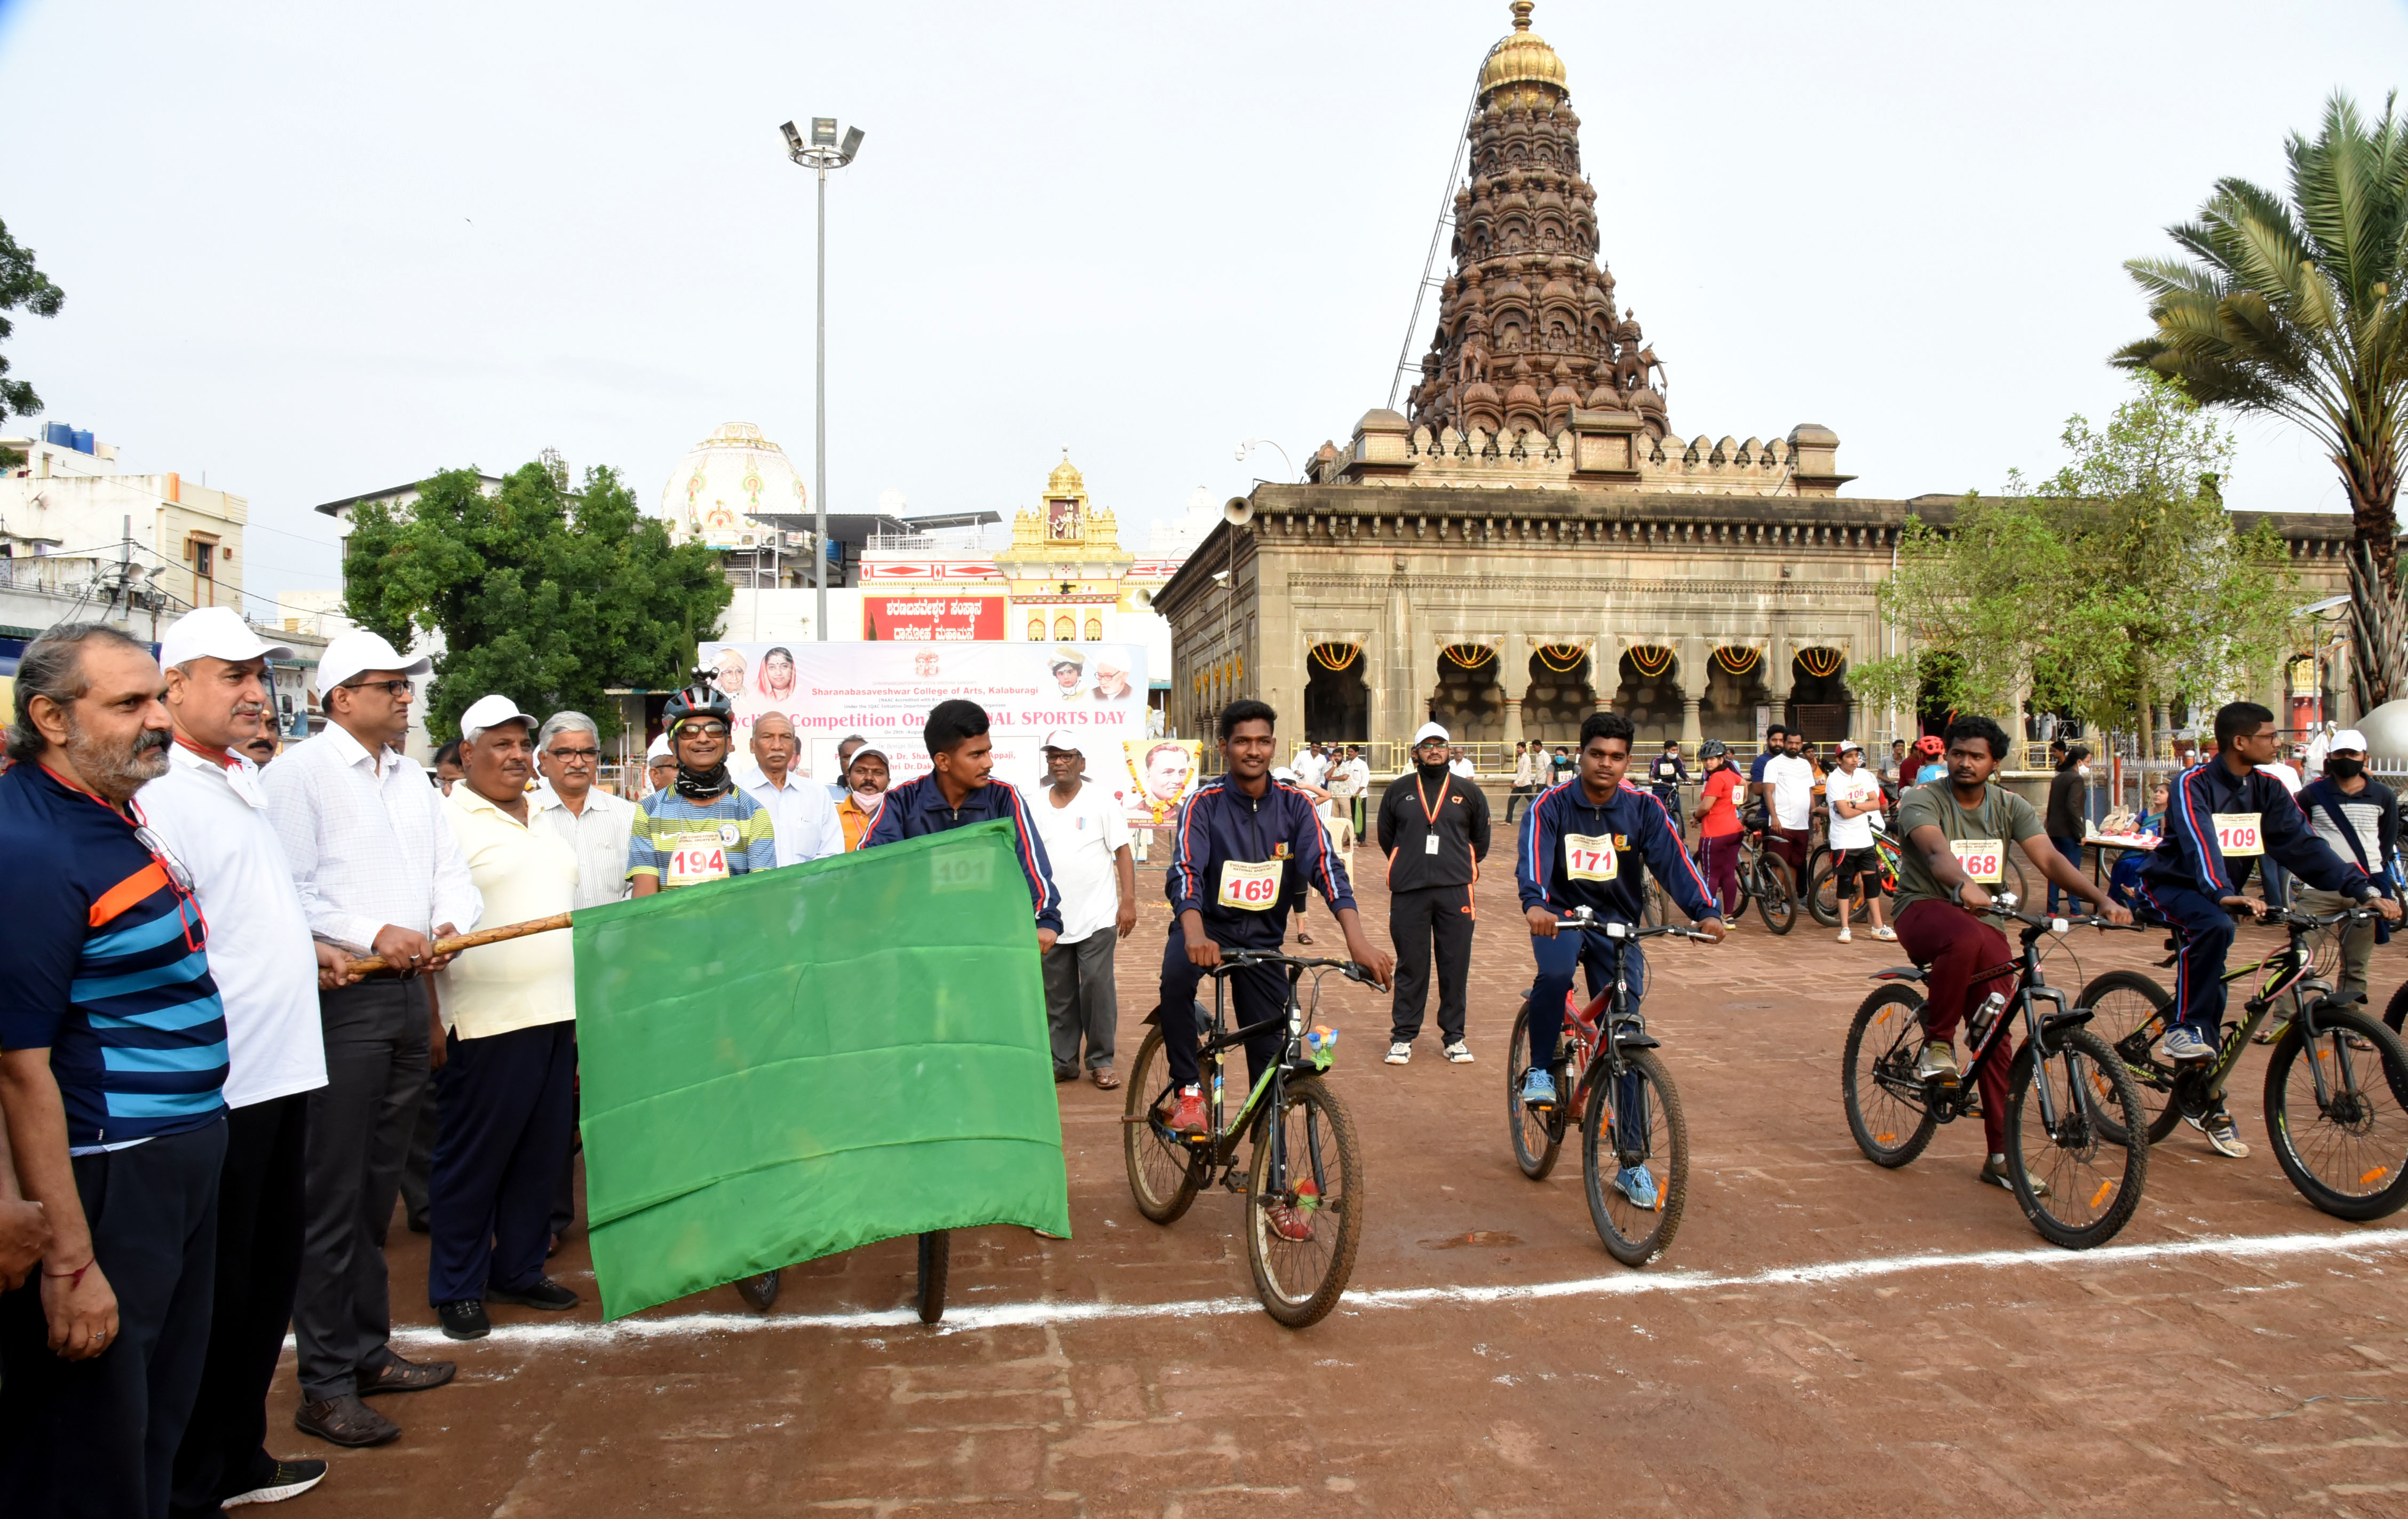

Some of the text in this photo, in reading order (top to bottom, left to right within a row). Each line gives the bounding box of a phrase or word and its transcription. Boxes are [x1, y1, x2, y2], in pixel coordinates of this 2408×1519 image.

[812, 688, 910, 696] Sharanabasaveshwar
[913, 687, 948, 696] College
[963, 687, 985, 695] Arts,
[988, 687, 1038, 695] Kalaburagi
[789, 713, 896, 730] Competition
[902, 713, 925, 726] On
[1021, 711, 1088, 725] SPORTS
[1094, 711, 1126, 724] DAY
[1451, 796, 1463, 804] C7
[1848, 788, 1864, 800] 106
[2219, 828, 2255, 847] 109
[675, 849, 724, 874] 194
[1571, 849, 1611, 871] 171
[1229, 878, 1274, 901] 169
